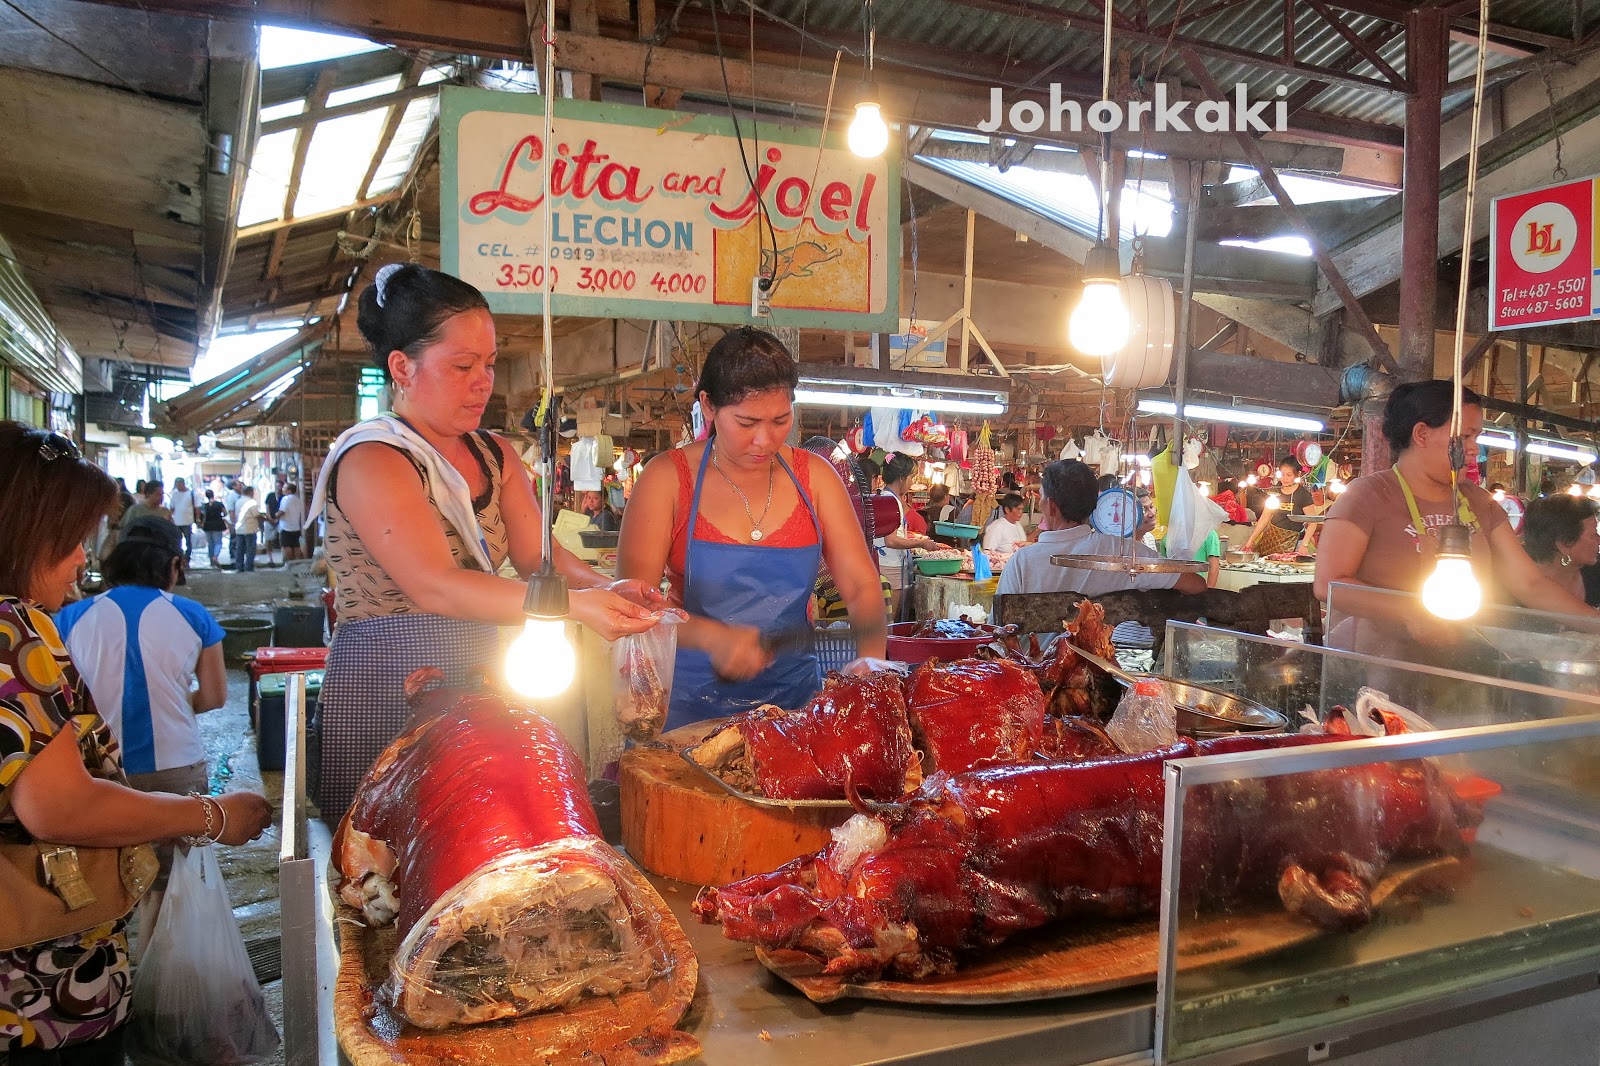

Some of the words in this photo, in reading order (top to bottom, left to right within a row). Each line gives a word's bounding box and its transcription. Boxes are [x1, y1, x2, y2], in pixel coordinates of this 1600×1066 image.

[469, 135, 654, 216] Lita
[663, 167, 726, 196] and
[552, 212, 693, 250] LECHON
[525, 246, 539, 256] #
[496, 264, 559, 288] 3,500
[576, 267, 636, 292] 3,000
[650, 271, 707, 294] 4,000
[1501, 306, 1526, 318] Store
